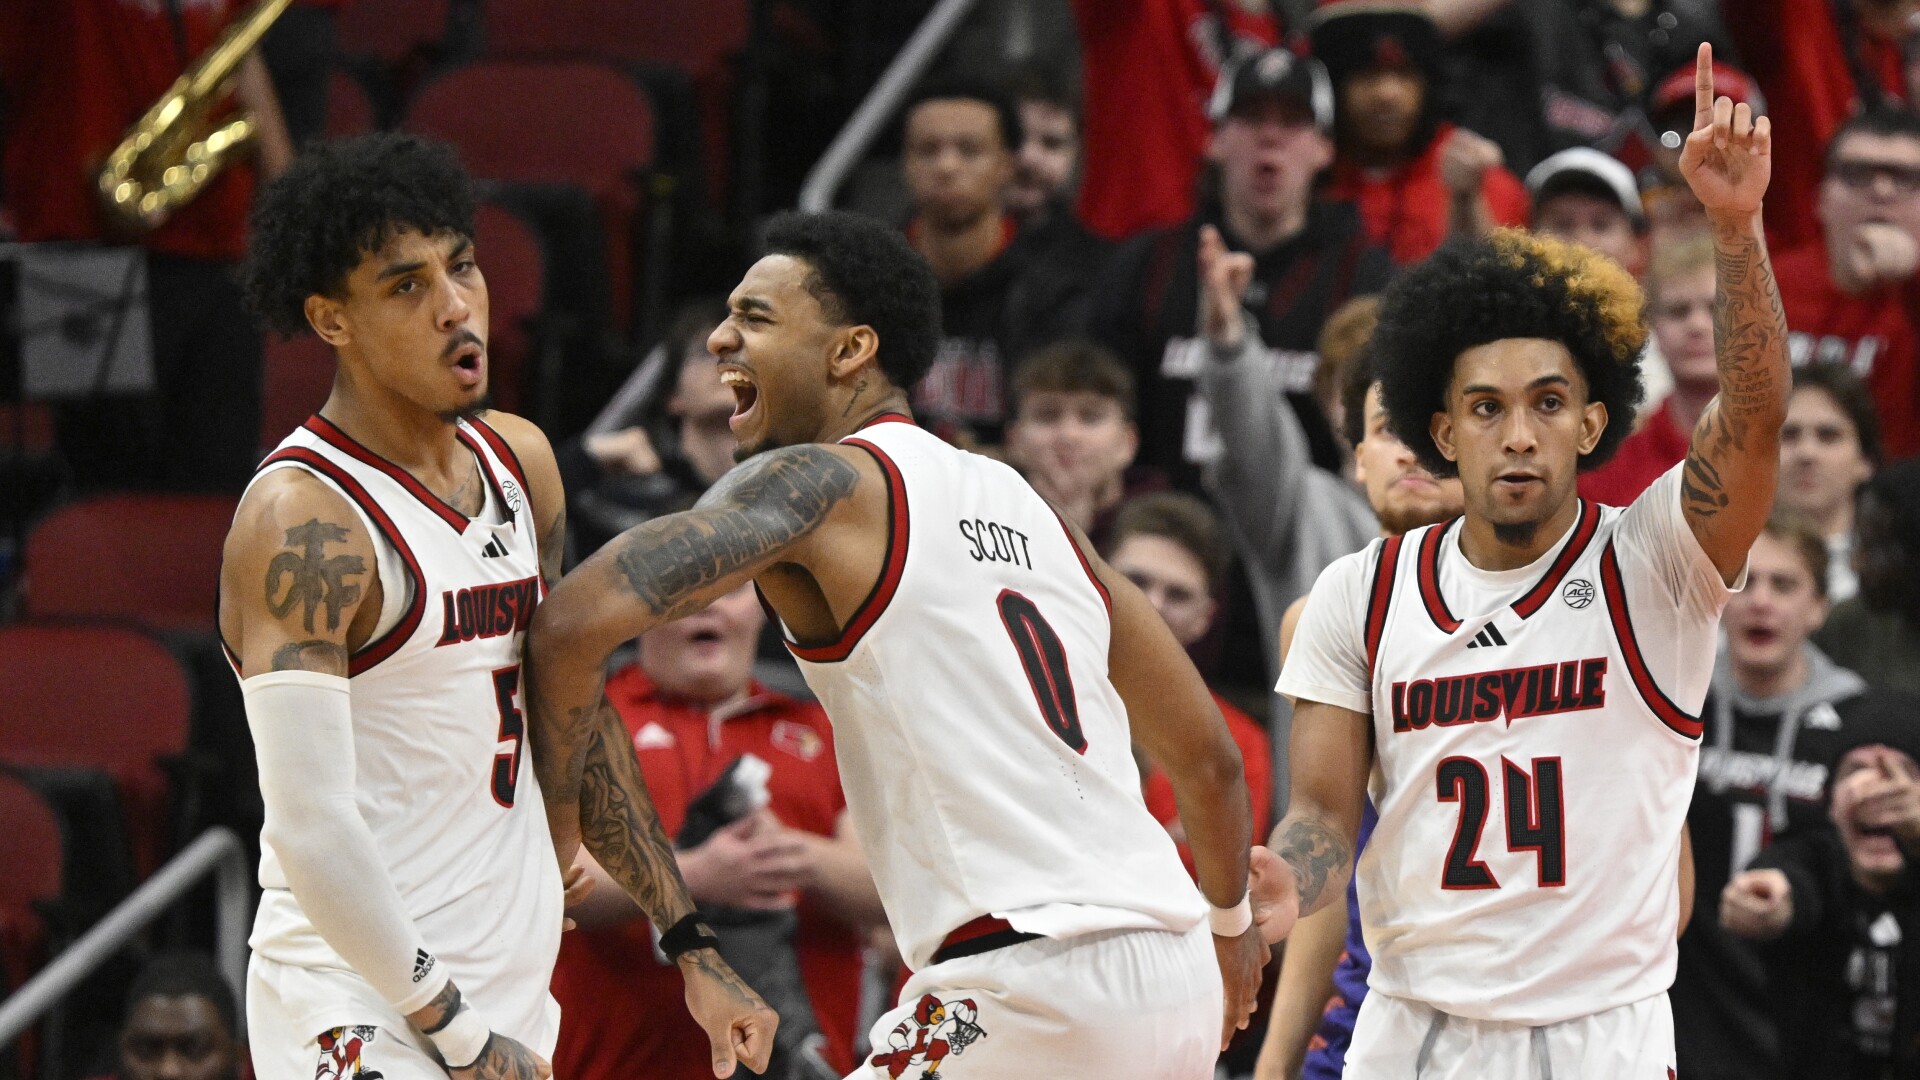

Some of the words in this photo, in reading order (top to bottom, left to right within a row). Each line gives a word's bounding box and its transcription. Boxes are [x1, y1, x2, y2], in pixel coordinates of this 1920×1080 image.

[958, 518, 1033, 570] SCOTT
[434, 575, 538, 648] LOUISVI
[996, 588, 1089, 756] 0
[1391, 657, 1608, 733] LOUISVILLE
[490, 664, 524, 808] 5
[1436, 754, 1566, 890] 24
[412, 955, 436, 983] adidas
